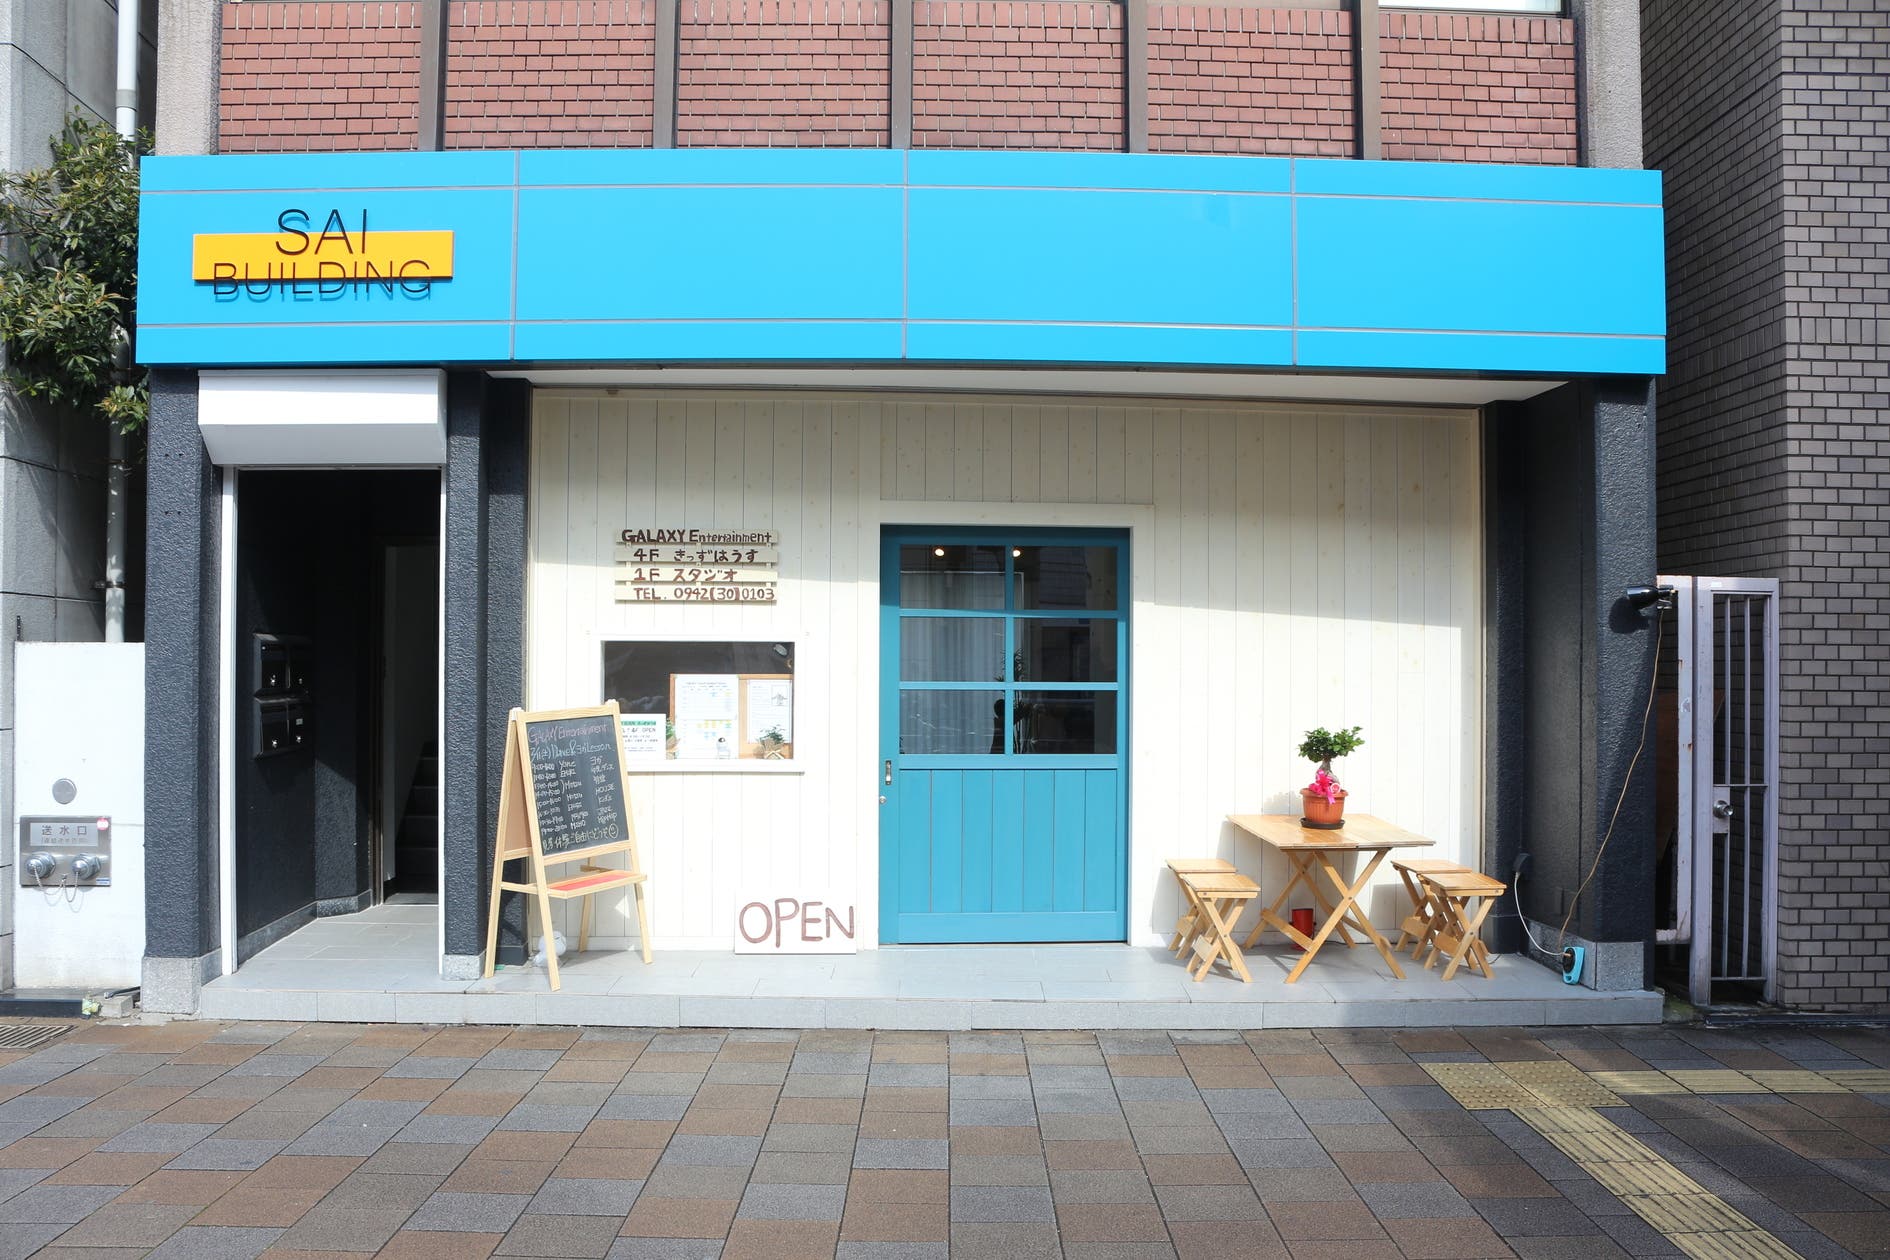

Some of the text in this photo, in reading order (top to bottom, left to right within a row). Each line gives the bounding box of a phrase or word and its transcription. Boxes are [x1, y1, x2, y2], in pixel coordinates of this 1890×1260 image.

[275, 208, 367, 256] SAI
[213, 260, 431, 296] BUILDING
[621, 529, 772, 543] GALAXY Entertainment
[633, 548, 759, 563] 4F きっずはうす
[633, 567, 738, 582] 1F スタジオ
[41, 825, 88, 836] 送水口
[739, 897, 854, 948] OPEN
